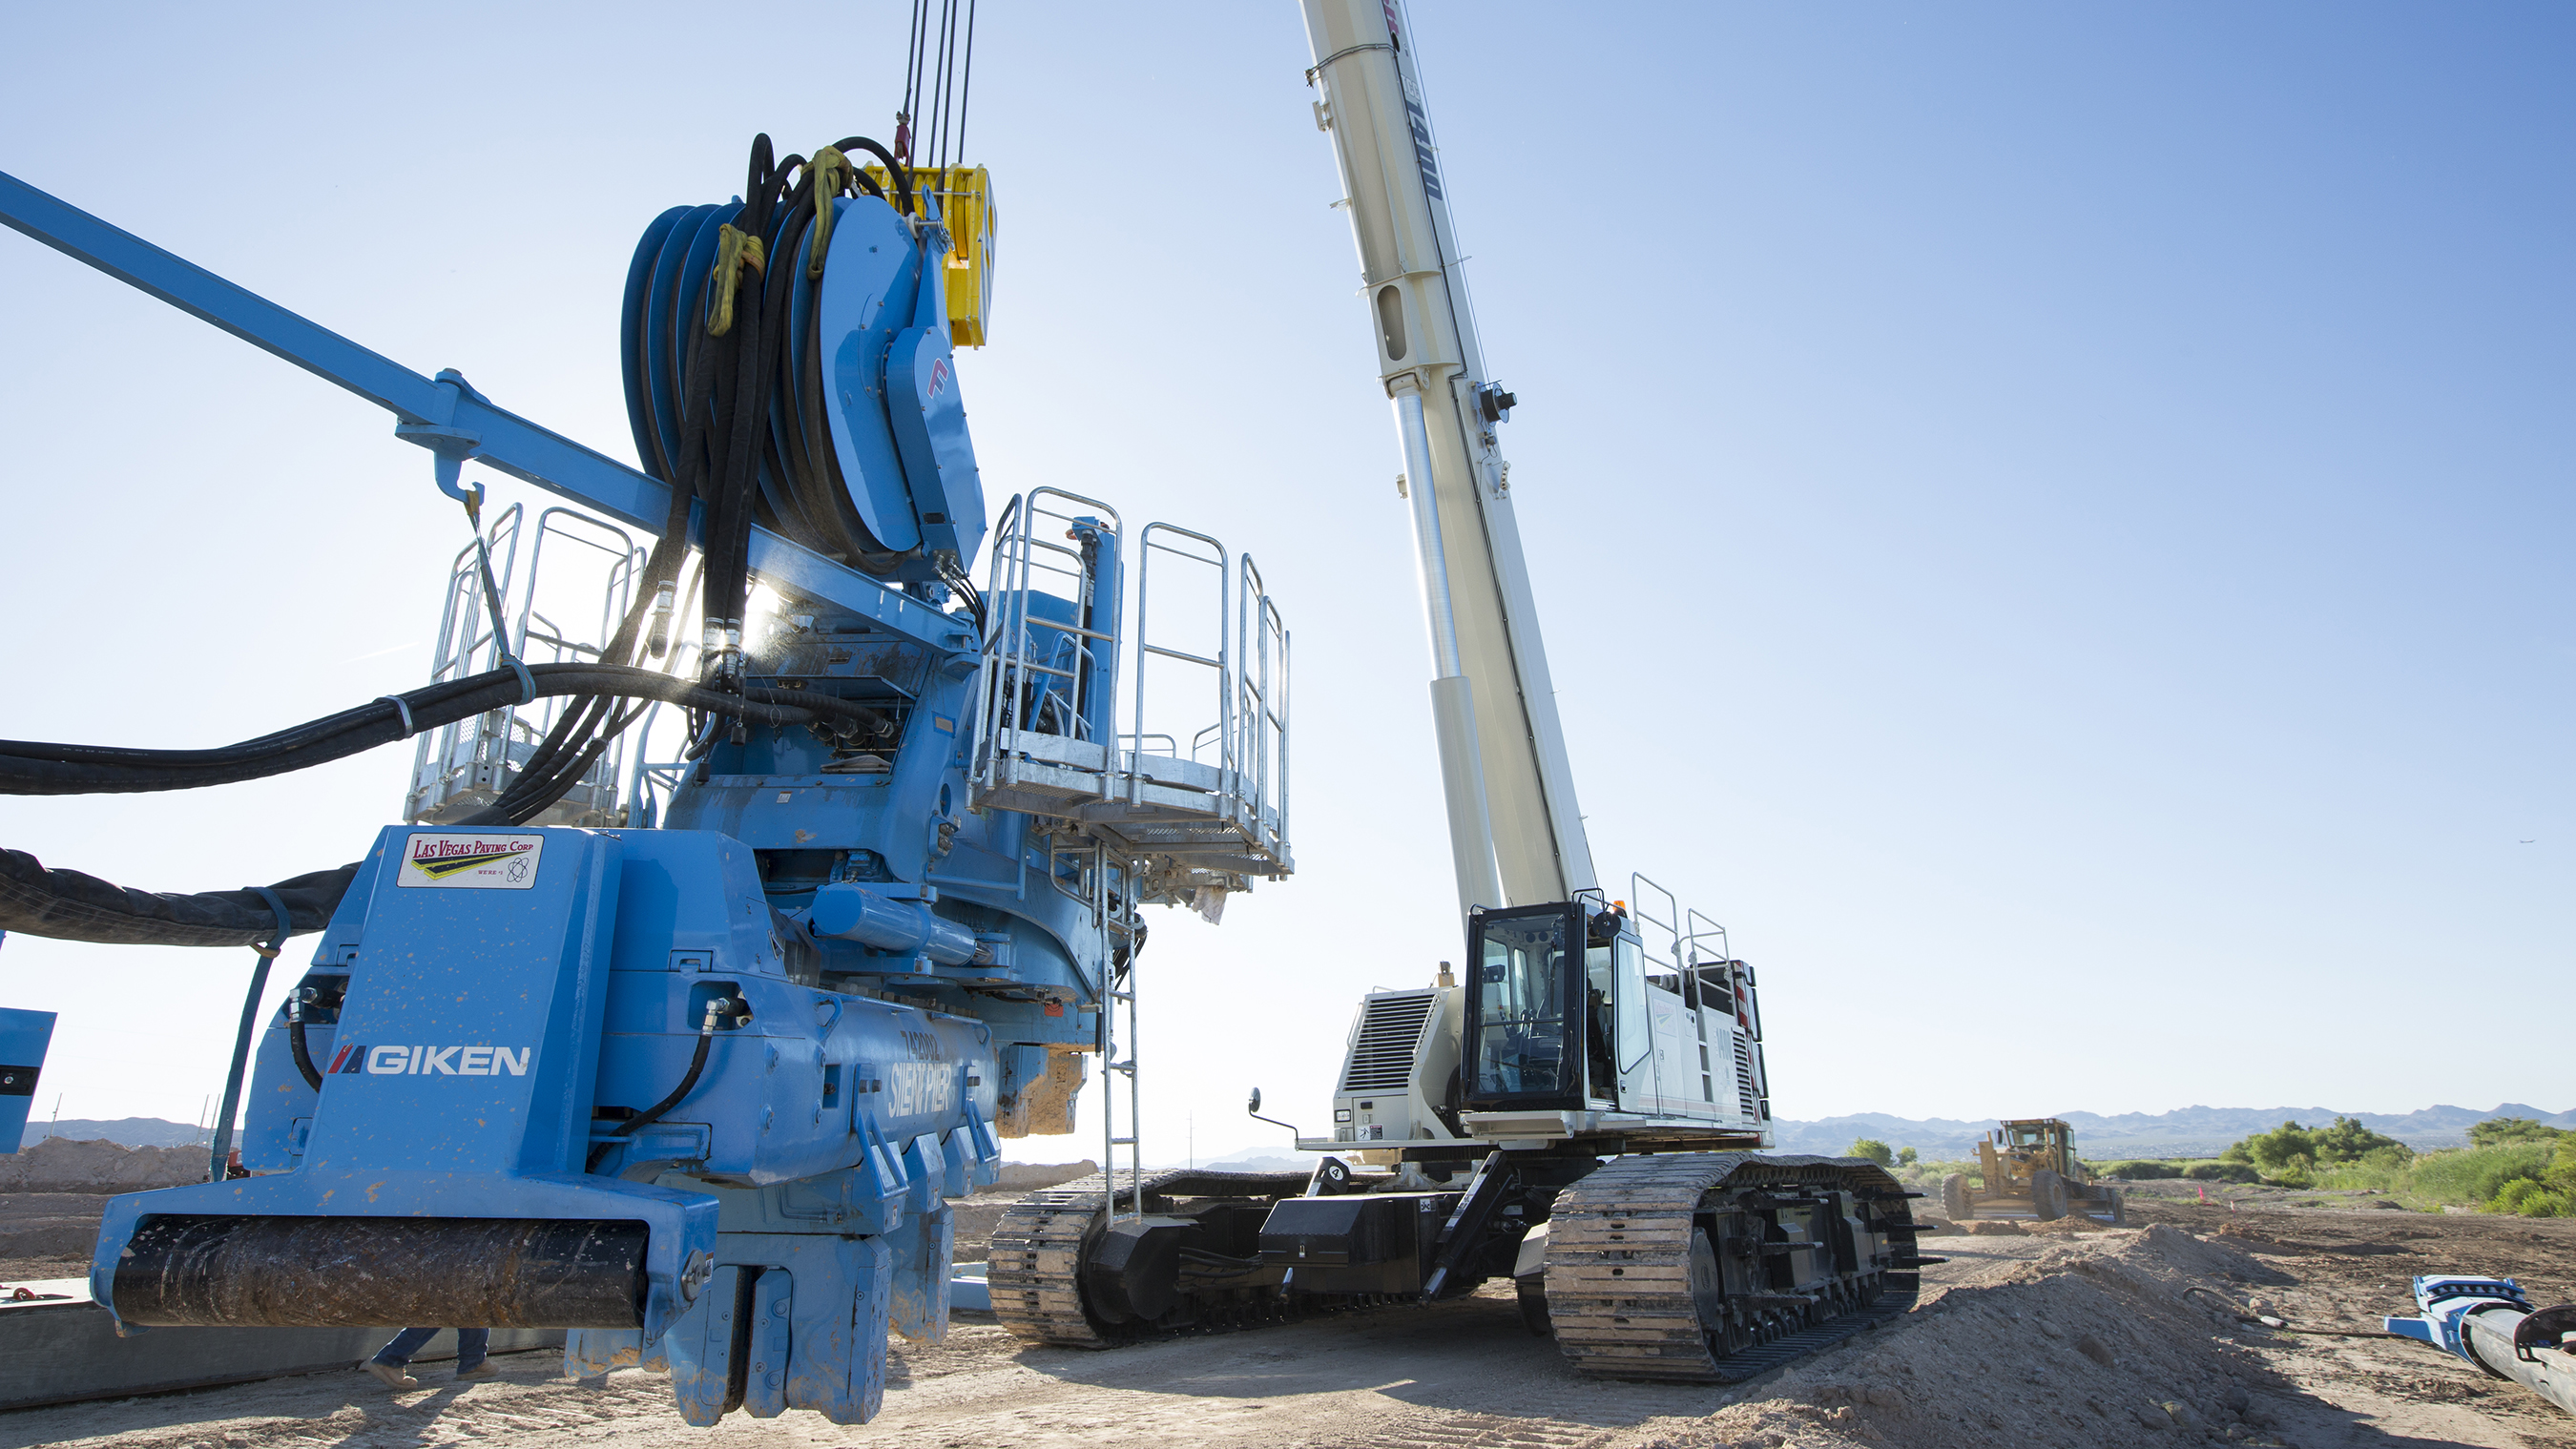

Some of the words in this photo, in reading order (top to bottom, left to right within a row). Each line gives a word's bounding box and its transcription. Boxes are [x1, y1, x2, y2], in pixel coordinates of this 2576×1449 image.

[1406, 99, 1444, 201] 1400
[412, 839, 437, 859] LAS
[438, 839, 472, 858] VEGAS
[472, 840, 507, 855] PAVING
[366, 1045, 530, 1076] GIKEN
[900, 1030, 940, 1062] 742002
[888, 1063, 926, 1118] SILENT
[924, 1062, 952, 1114] PILER
[1331, 1168, 1340, 1179] 4
